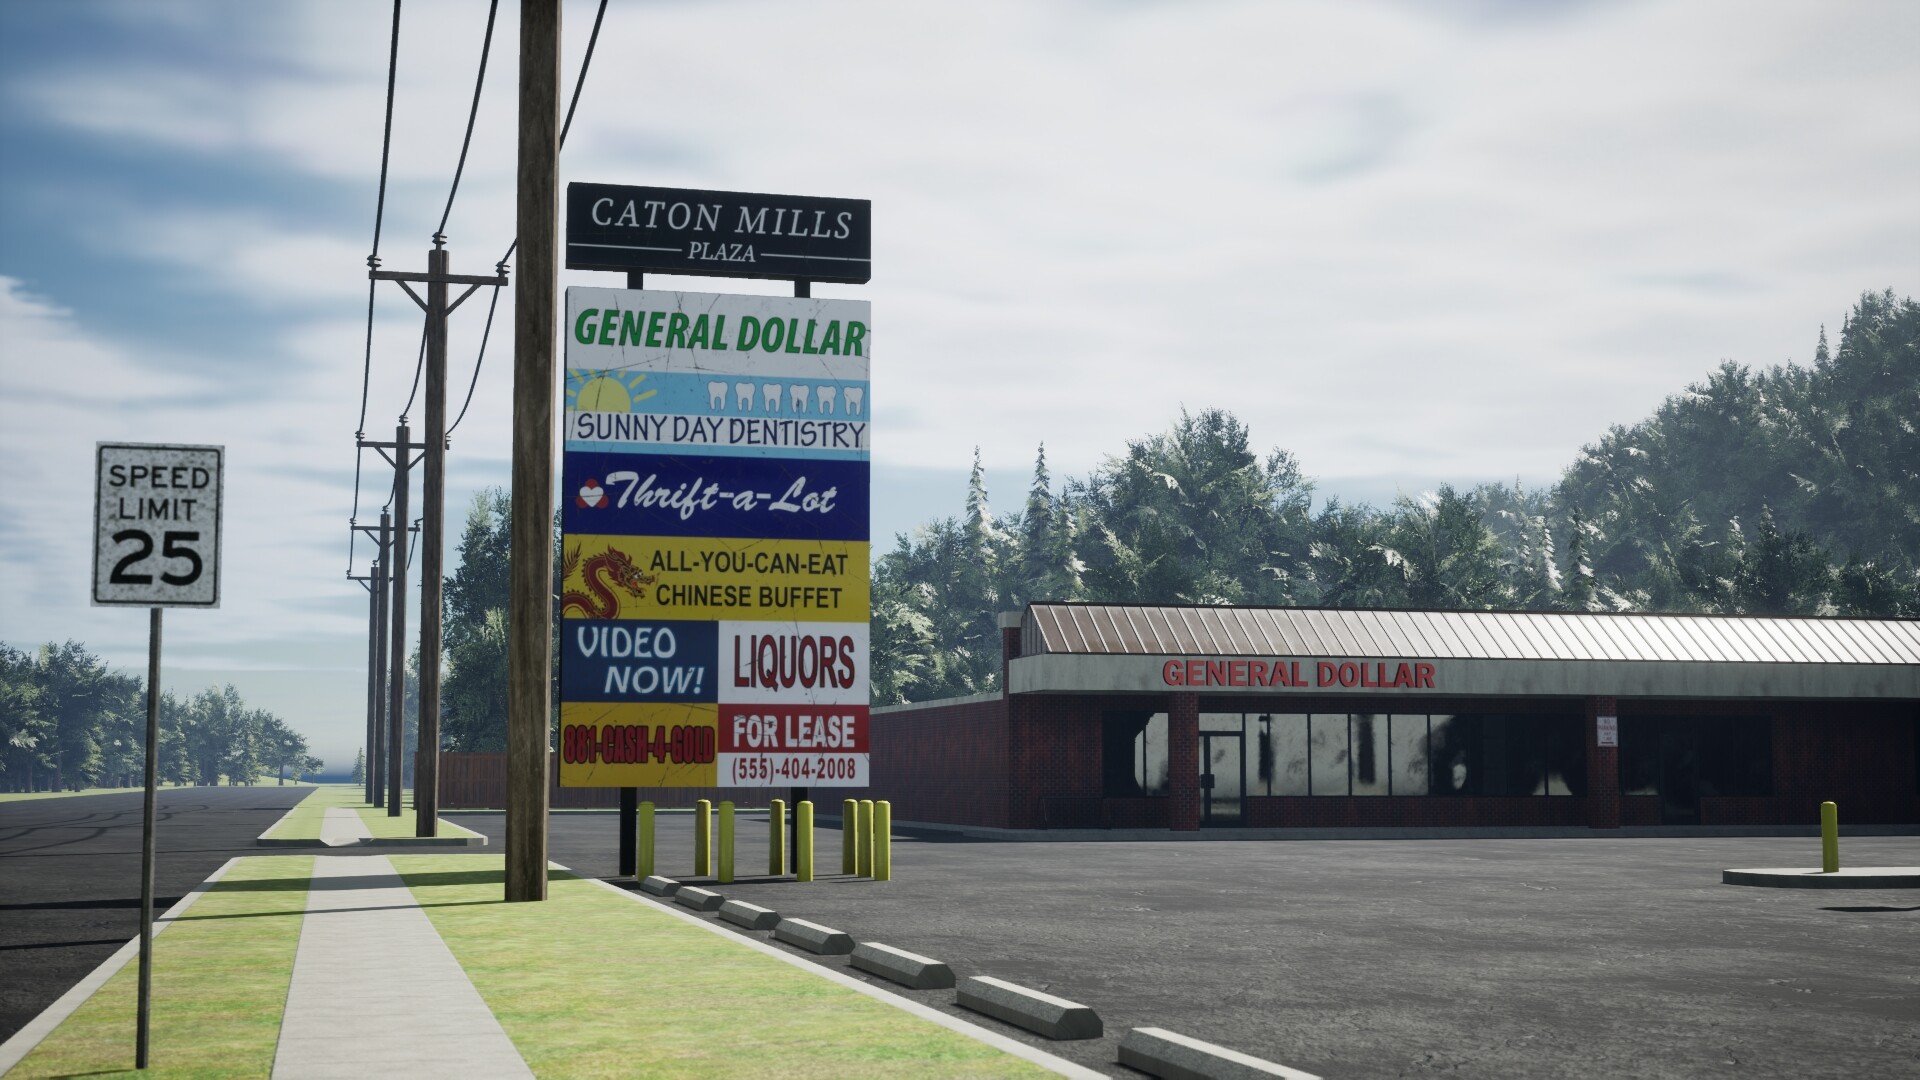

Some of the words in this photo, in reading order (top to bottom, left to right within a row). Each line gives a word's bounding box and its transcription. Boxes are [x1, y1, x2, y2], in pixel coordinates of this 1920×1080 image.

[592, 198, 722, 231] CATON
[734, 206, 852, 239] MILLS
[687, 242, 756, 262] PLAZA
[574, 308, 727, 351] GENERAL
[736, 315, 866, 356] DOLLAR
[577, 413, 667, 442] SUNNY
[673, 416, 724, 443] DAY
[729, 418, 866, 448] DENTISTRY
[109, 464, 210, 489] SPEED
[119, 497, 197, 521] LIMIT
[605, 471, 838, 520] Thrift-a-Lot
[109, 529, 203, 586] 25
[650, 550, 848, 575] ALL-YOU-CAN-EAT
[656, 584, 752, 607] CHINESE
[759, 586, 842, 609] BUFFET
[577, 626, 676, 658] VIDEO
[734, 634, 855, 692] LIQUORS
[1162, 659, 1309, 687] GENERAL
[1316, 661, 1436, 688] DOLLAR
[604, 666, 705, 694] NOW!
[563, 724, 715, 765] 881-CASH-4-GOLD
[733, 714, 779, 747] FOR
[785, 715, 856, 748] LEASE
[732, 757, 856, 785] (555)-404-2008
